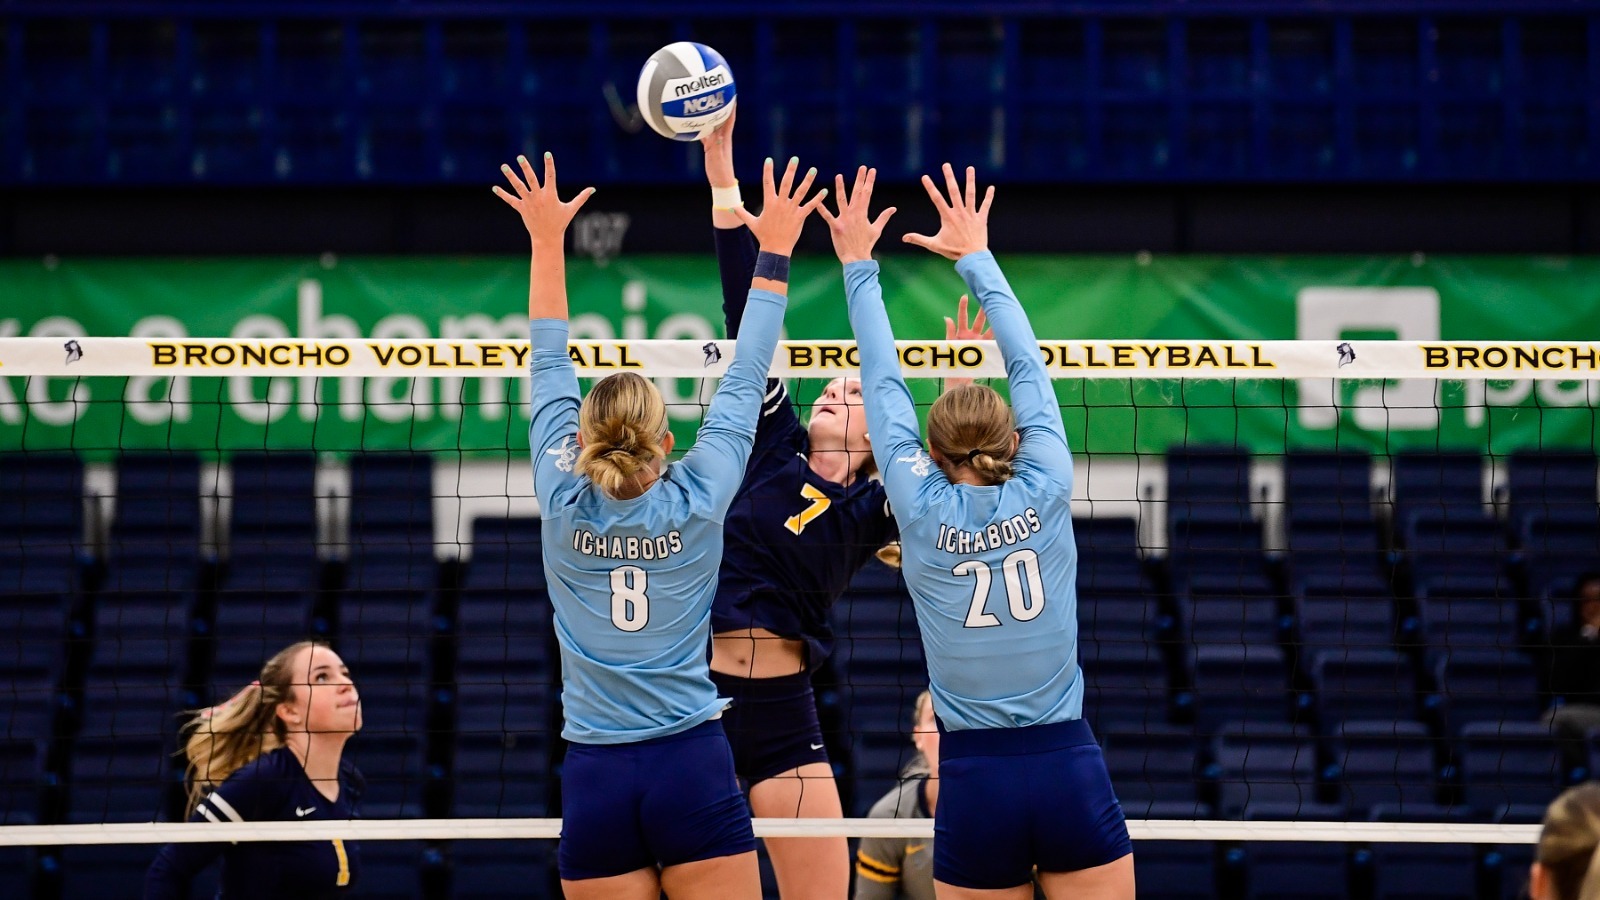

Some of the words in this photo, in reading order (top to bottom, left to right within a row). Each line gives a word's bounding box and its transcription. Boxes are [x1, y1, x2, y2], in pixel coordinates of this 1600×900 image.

[675, 73, 726, 97] molten
[683, 91, 725, 114] NCAA
[149, 343, 352, 368] BRONCHO
[367, 343, 644, 369] VOLLEYALL
[227, 279, 789, 424] chamio
[785, 344, 985, 369] BROCHO
[1039, 344, 1278, 370] LLEYBALL
[1419, 345, 1600, 371] BRONCH
[784, 483, 831, 536] 7
[573, 529, 683, 560] ICHABODS
[936, 507, 1041, 554] ICHABODS
[609, 565, 650, 632] 8
[952, 548, 1046, 628] 20
